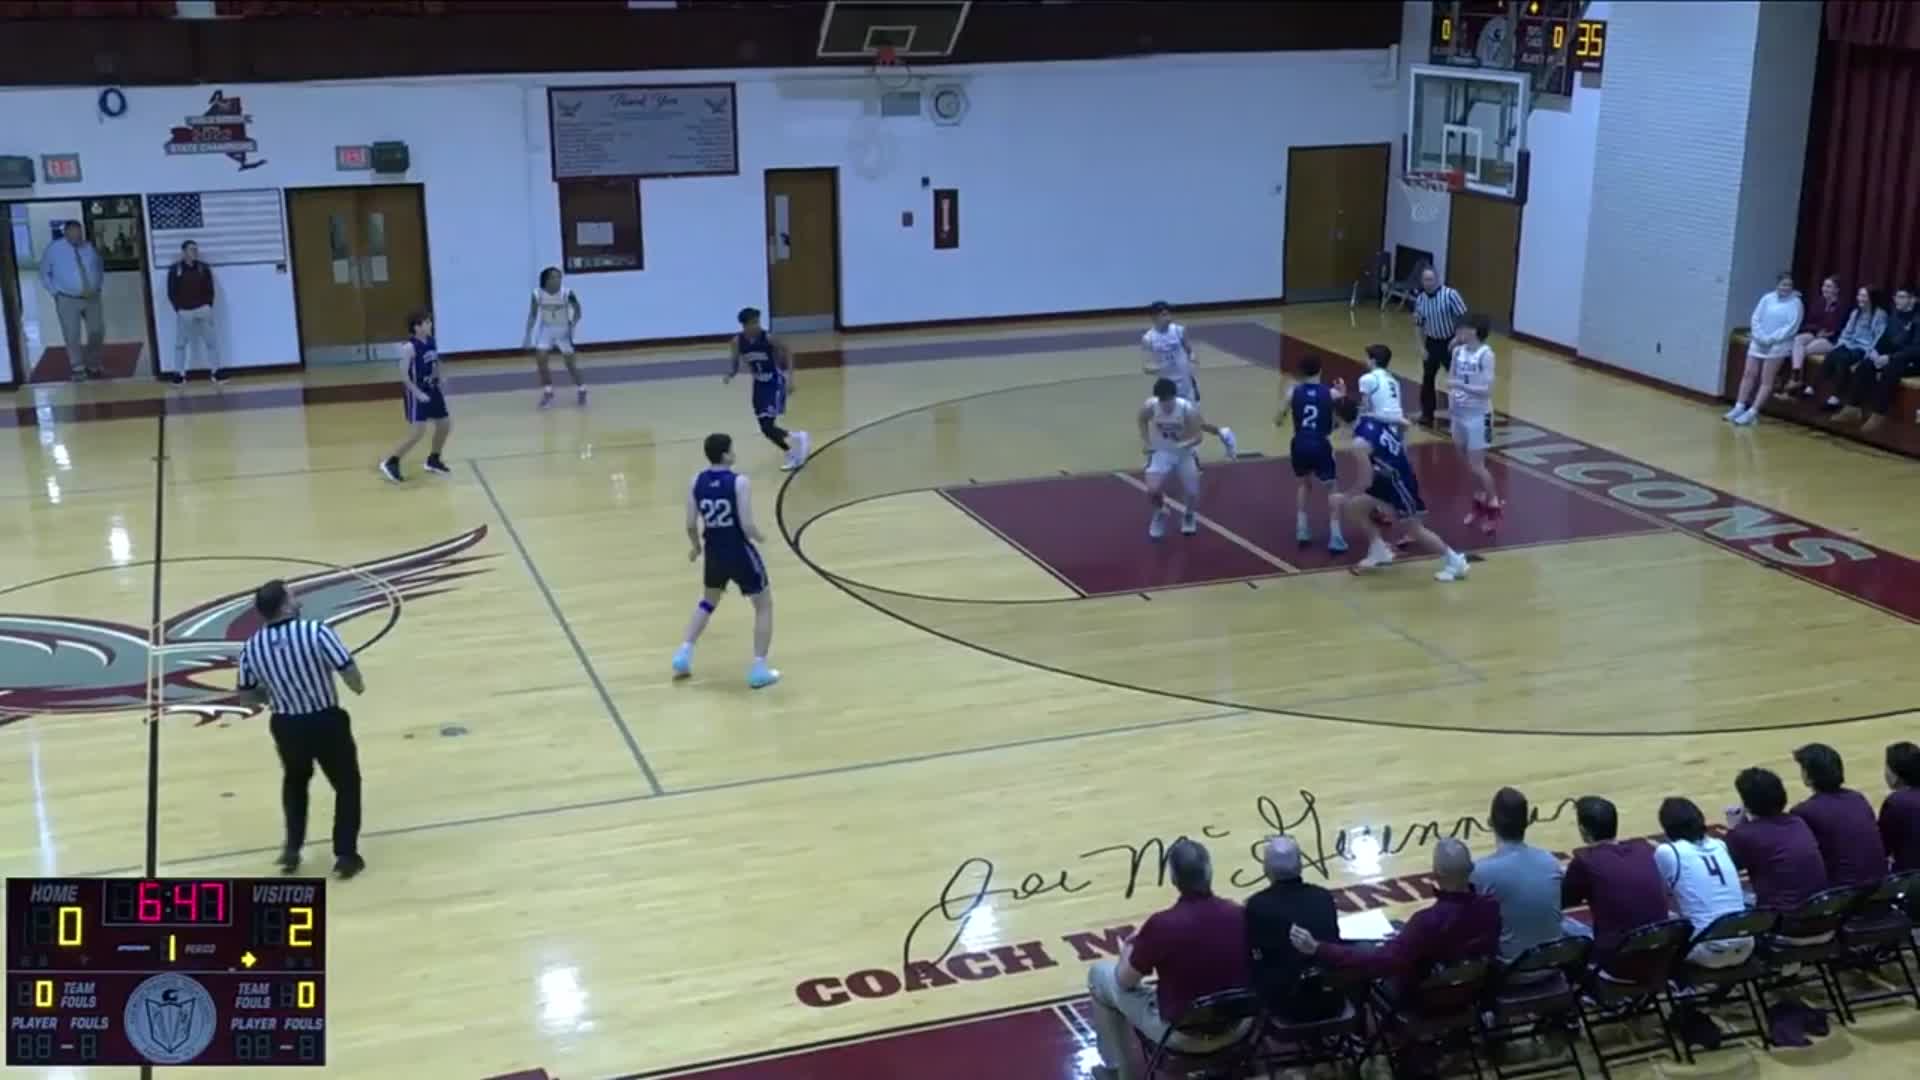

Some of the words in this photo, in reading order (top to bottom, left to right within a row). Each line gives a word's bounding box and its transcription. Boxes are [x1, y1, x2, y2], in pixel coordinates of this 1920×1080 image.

[1442, 19, 1451, 40] 0
[1552, 26, 1564, 48] 0
[1576, 23, 1603, 56] 35
[1302, 404, 1318, 430] 2
[1490, 424, 1878, 567] ALCONS
[700, 498, 735, 528] 22
[1699, 854, 1727, 886] 4
[795, 940, 1058, 1009] COACH
